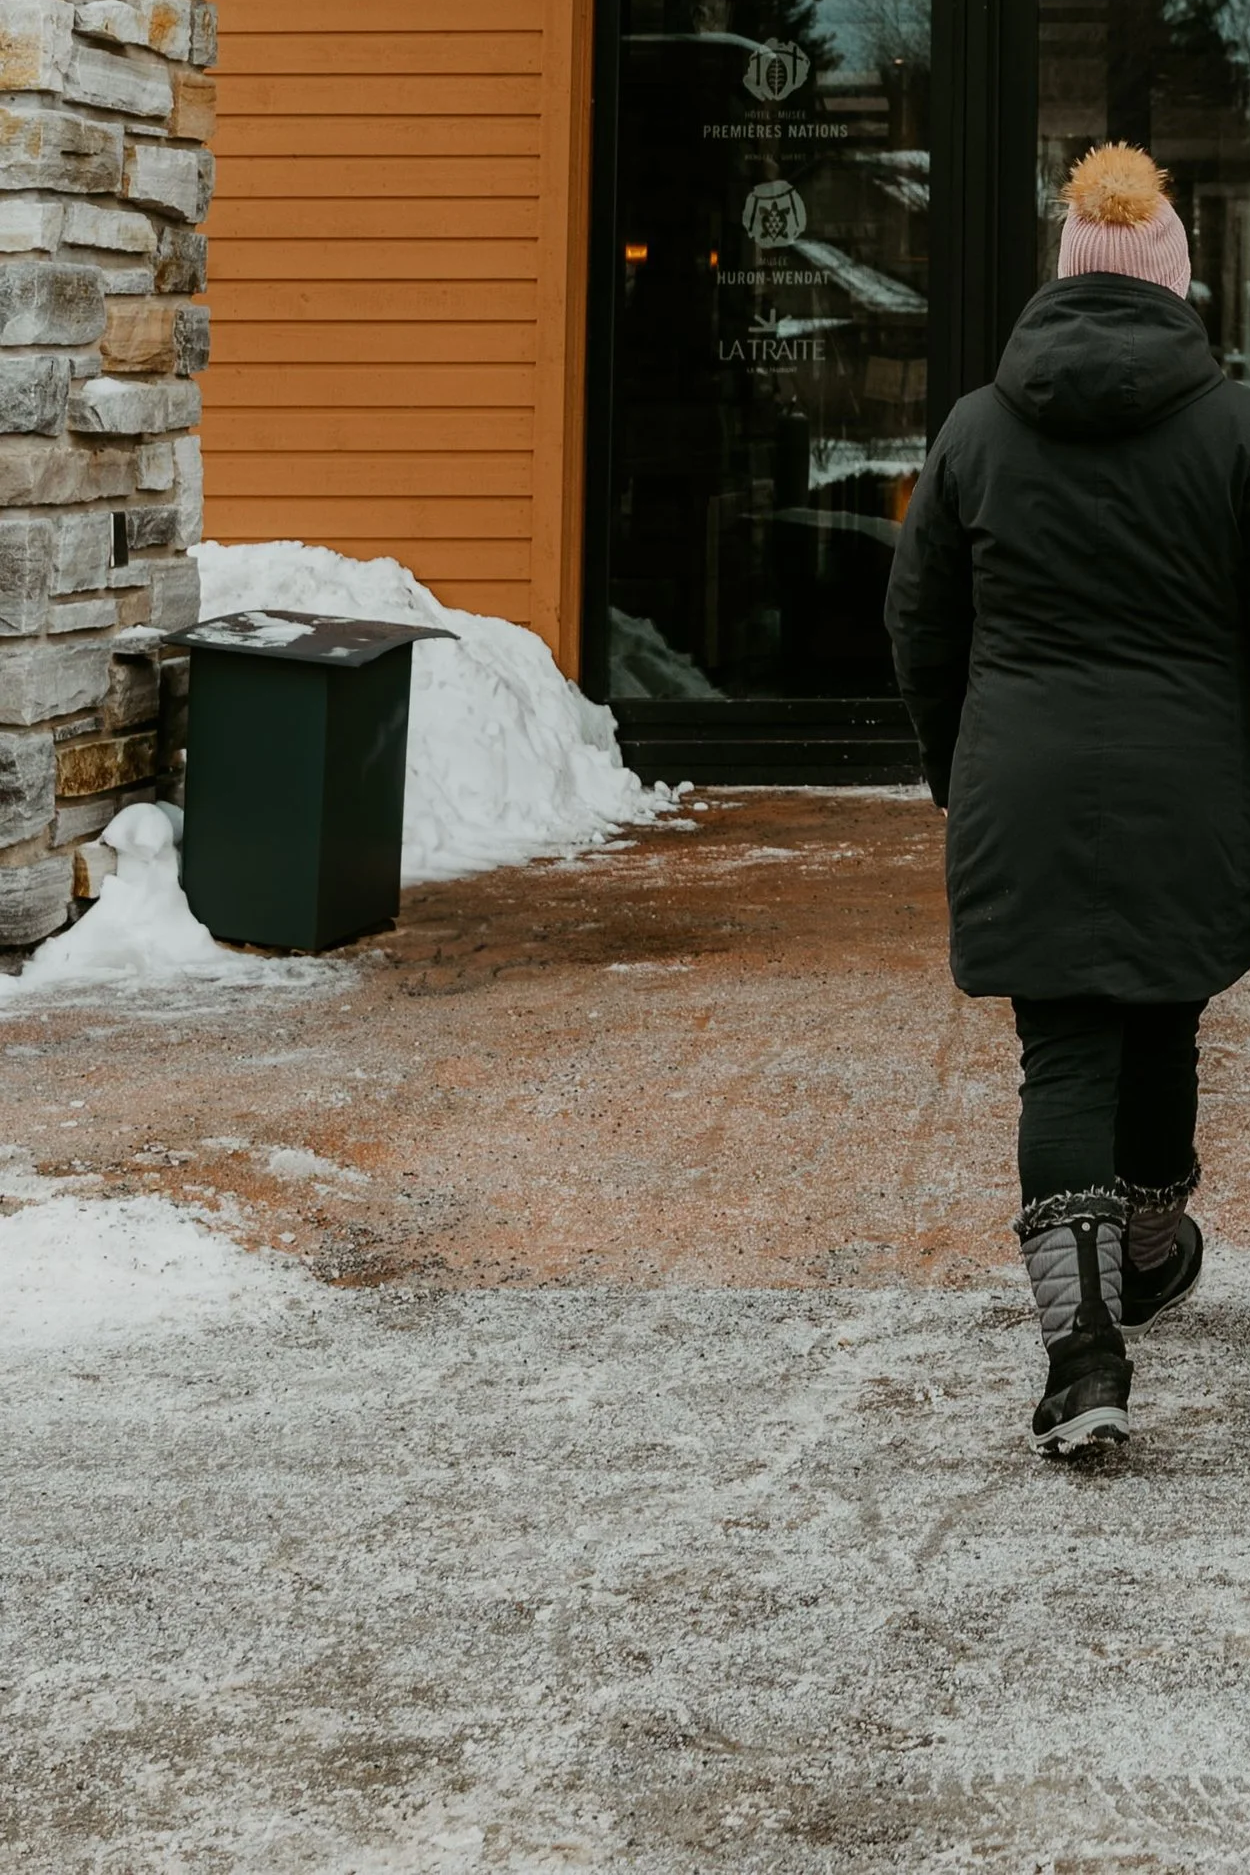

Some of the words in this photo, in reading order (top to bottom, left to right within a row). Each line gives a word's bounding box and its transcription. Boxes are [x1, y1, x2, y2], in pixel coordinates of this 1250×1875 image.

[703, 122, 782, 139] PREMIÈRES
[788, 124, 848, 138] NATIONS
[716, 271, 830, 285] HURON-WENDAT
[719, 339, 745, 361] LA
[747, 339, 826, 361] TRAITE
